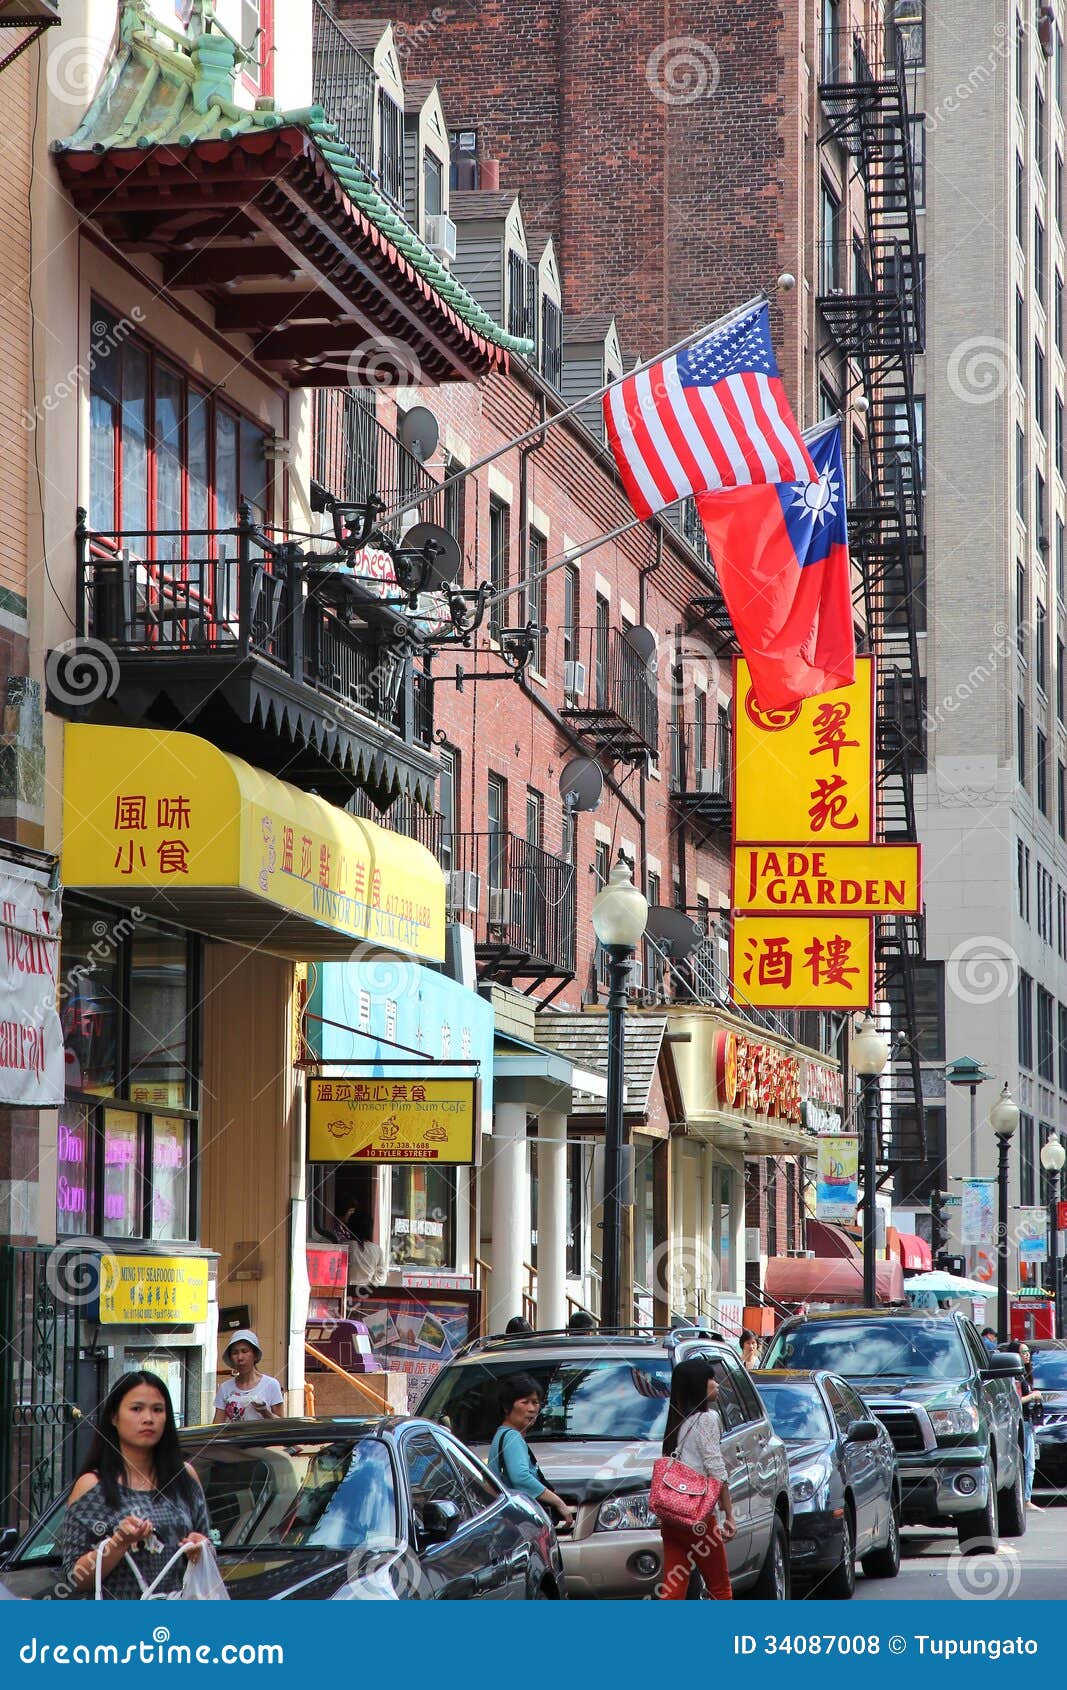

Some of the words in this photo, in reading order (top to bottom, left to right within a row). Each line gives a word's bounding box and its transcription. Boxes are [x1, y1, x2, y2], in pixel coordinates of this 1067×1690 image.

[808, 701, 861, 832] 翠苑
[114, 795, 191, 830] 風味
[114, 839, 189, 874] 小食
[748, 851, 828, 903] JADE
[766, 879, 906, 905] GARDEN
[312, 885, 350, 924] WINSOR
[374, 909, 397, 939] SUM
[397, 915, 421, 948] CAFE
[385, 894, 432, 929] 617.338.1688
[743, 934, 861, 991] 酒樓
[316, 1084, 427, 1102] 溫莎點心美食
[347, 1101, 387, 1112] Winsor
[415, 1101, 439, 1112] Sum
[441, 1101, 466, 1114] Cafe
[58, 1125, 83, 1163] Dim
[366, 1150, 376, 1158] 10
[378, 1150, 401, 1158] TYLER
[403, 1150, 433, 1159] STREET
[380, 1142, 430, 1150] 617.338.1688
[58, 1175, 86, 1213] Sum
